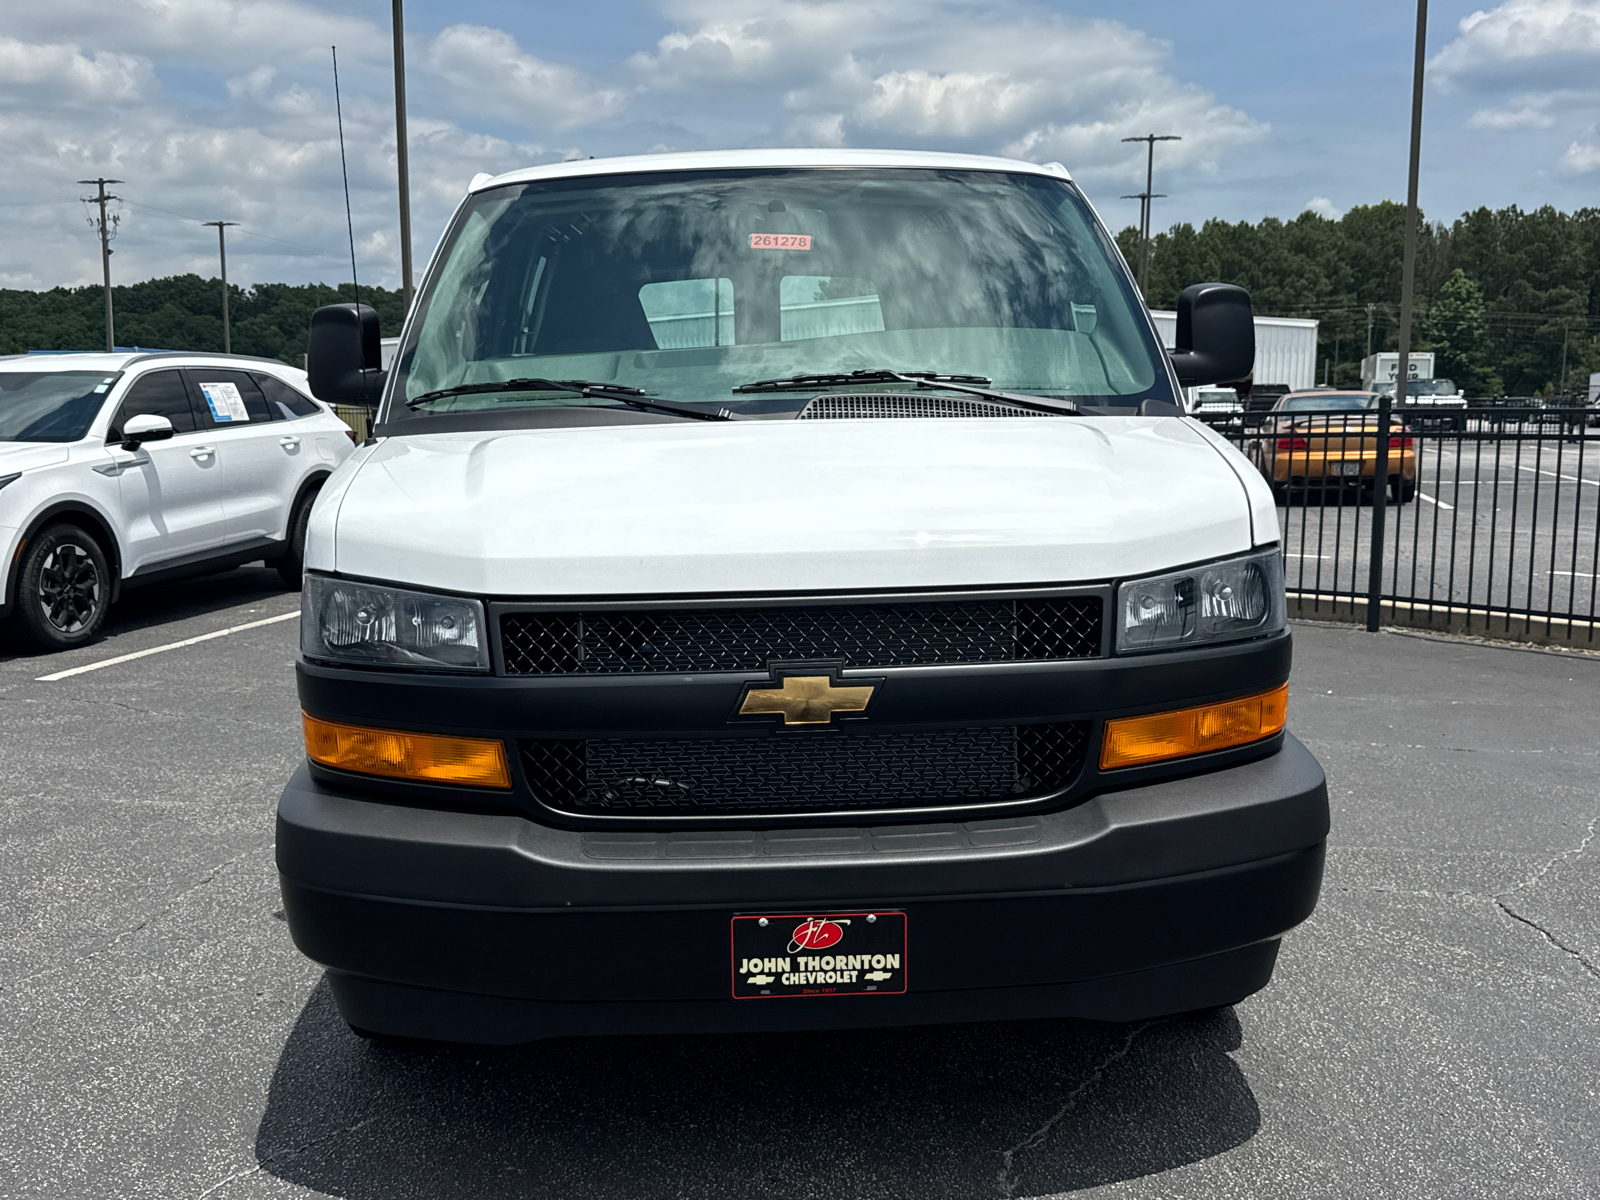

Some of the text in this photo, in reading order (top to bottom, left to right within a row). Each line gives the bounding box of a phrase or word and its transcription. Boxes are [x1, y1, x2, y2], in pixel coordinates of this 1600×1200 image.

[753, 235, 807, 247] 261278
[1390, 363, 1417, 372] FD
[739, 953, 900, 974] JOHN THORNTON
[781, 970, 859, 986] CHEVROLET
